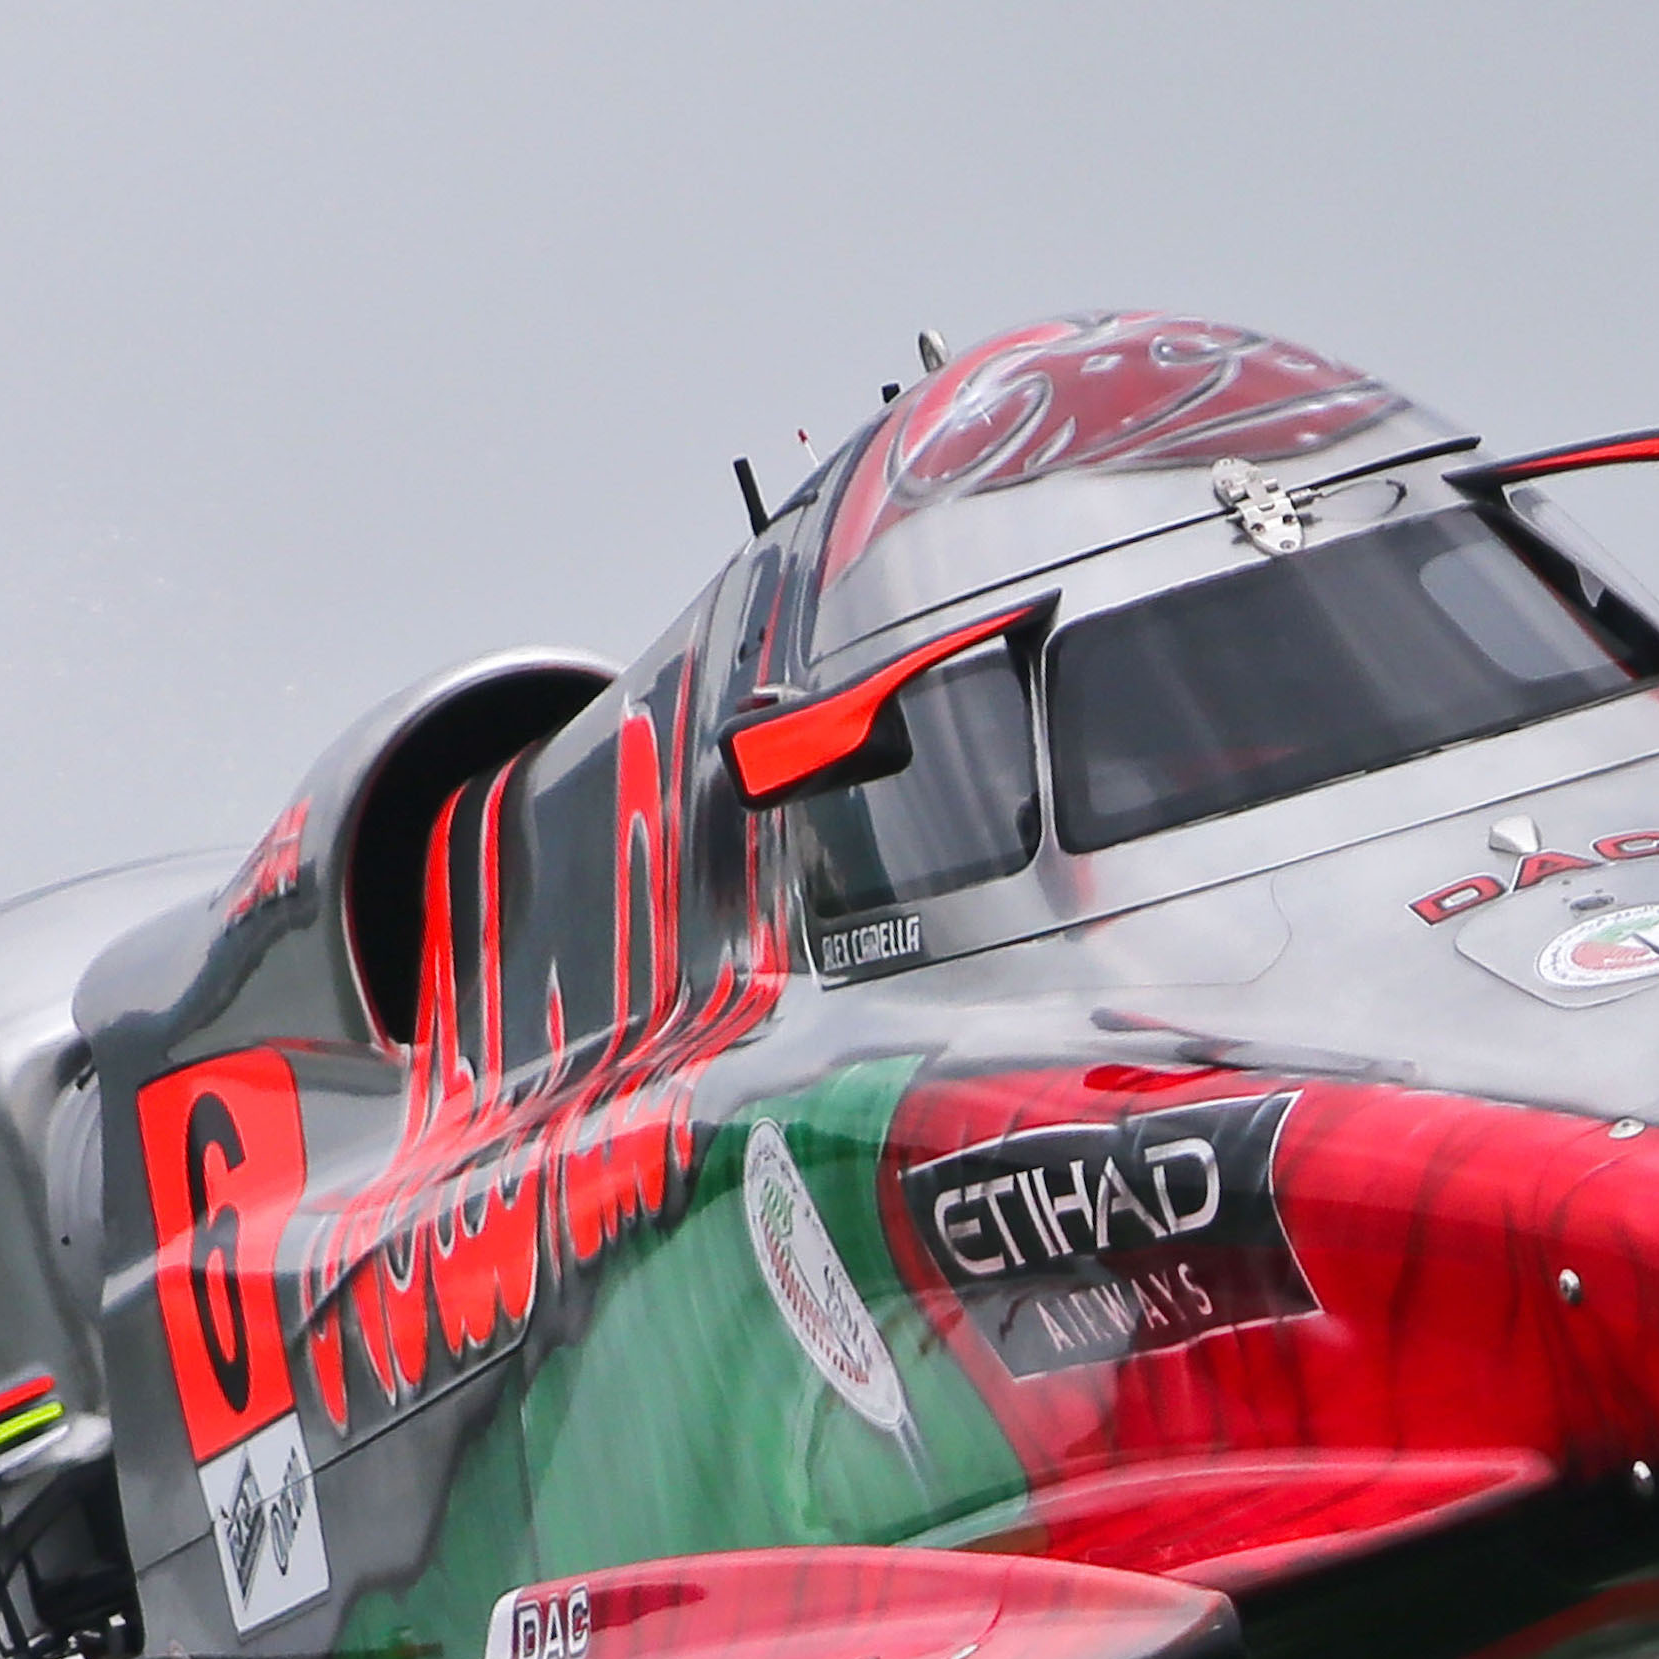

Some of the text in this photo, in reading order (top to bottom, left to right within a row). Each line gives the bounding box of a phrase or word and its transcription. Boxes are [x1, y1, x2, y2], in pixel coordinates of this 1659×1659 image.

[851, 914, 921, 965] CARELLA
[186, 1091, 252, 1414] 6
[934, 1137, 1221, 1276] ETIHAD
[1036, 1262, 1214, 1353] AIRWAYS
